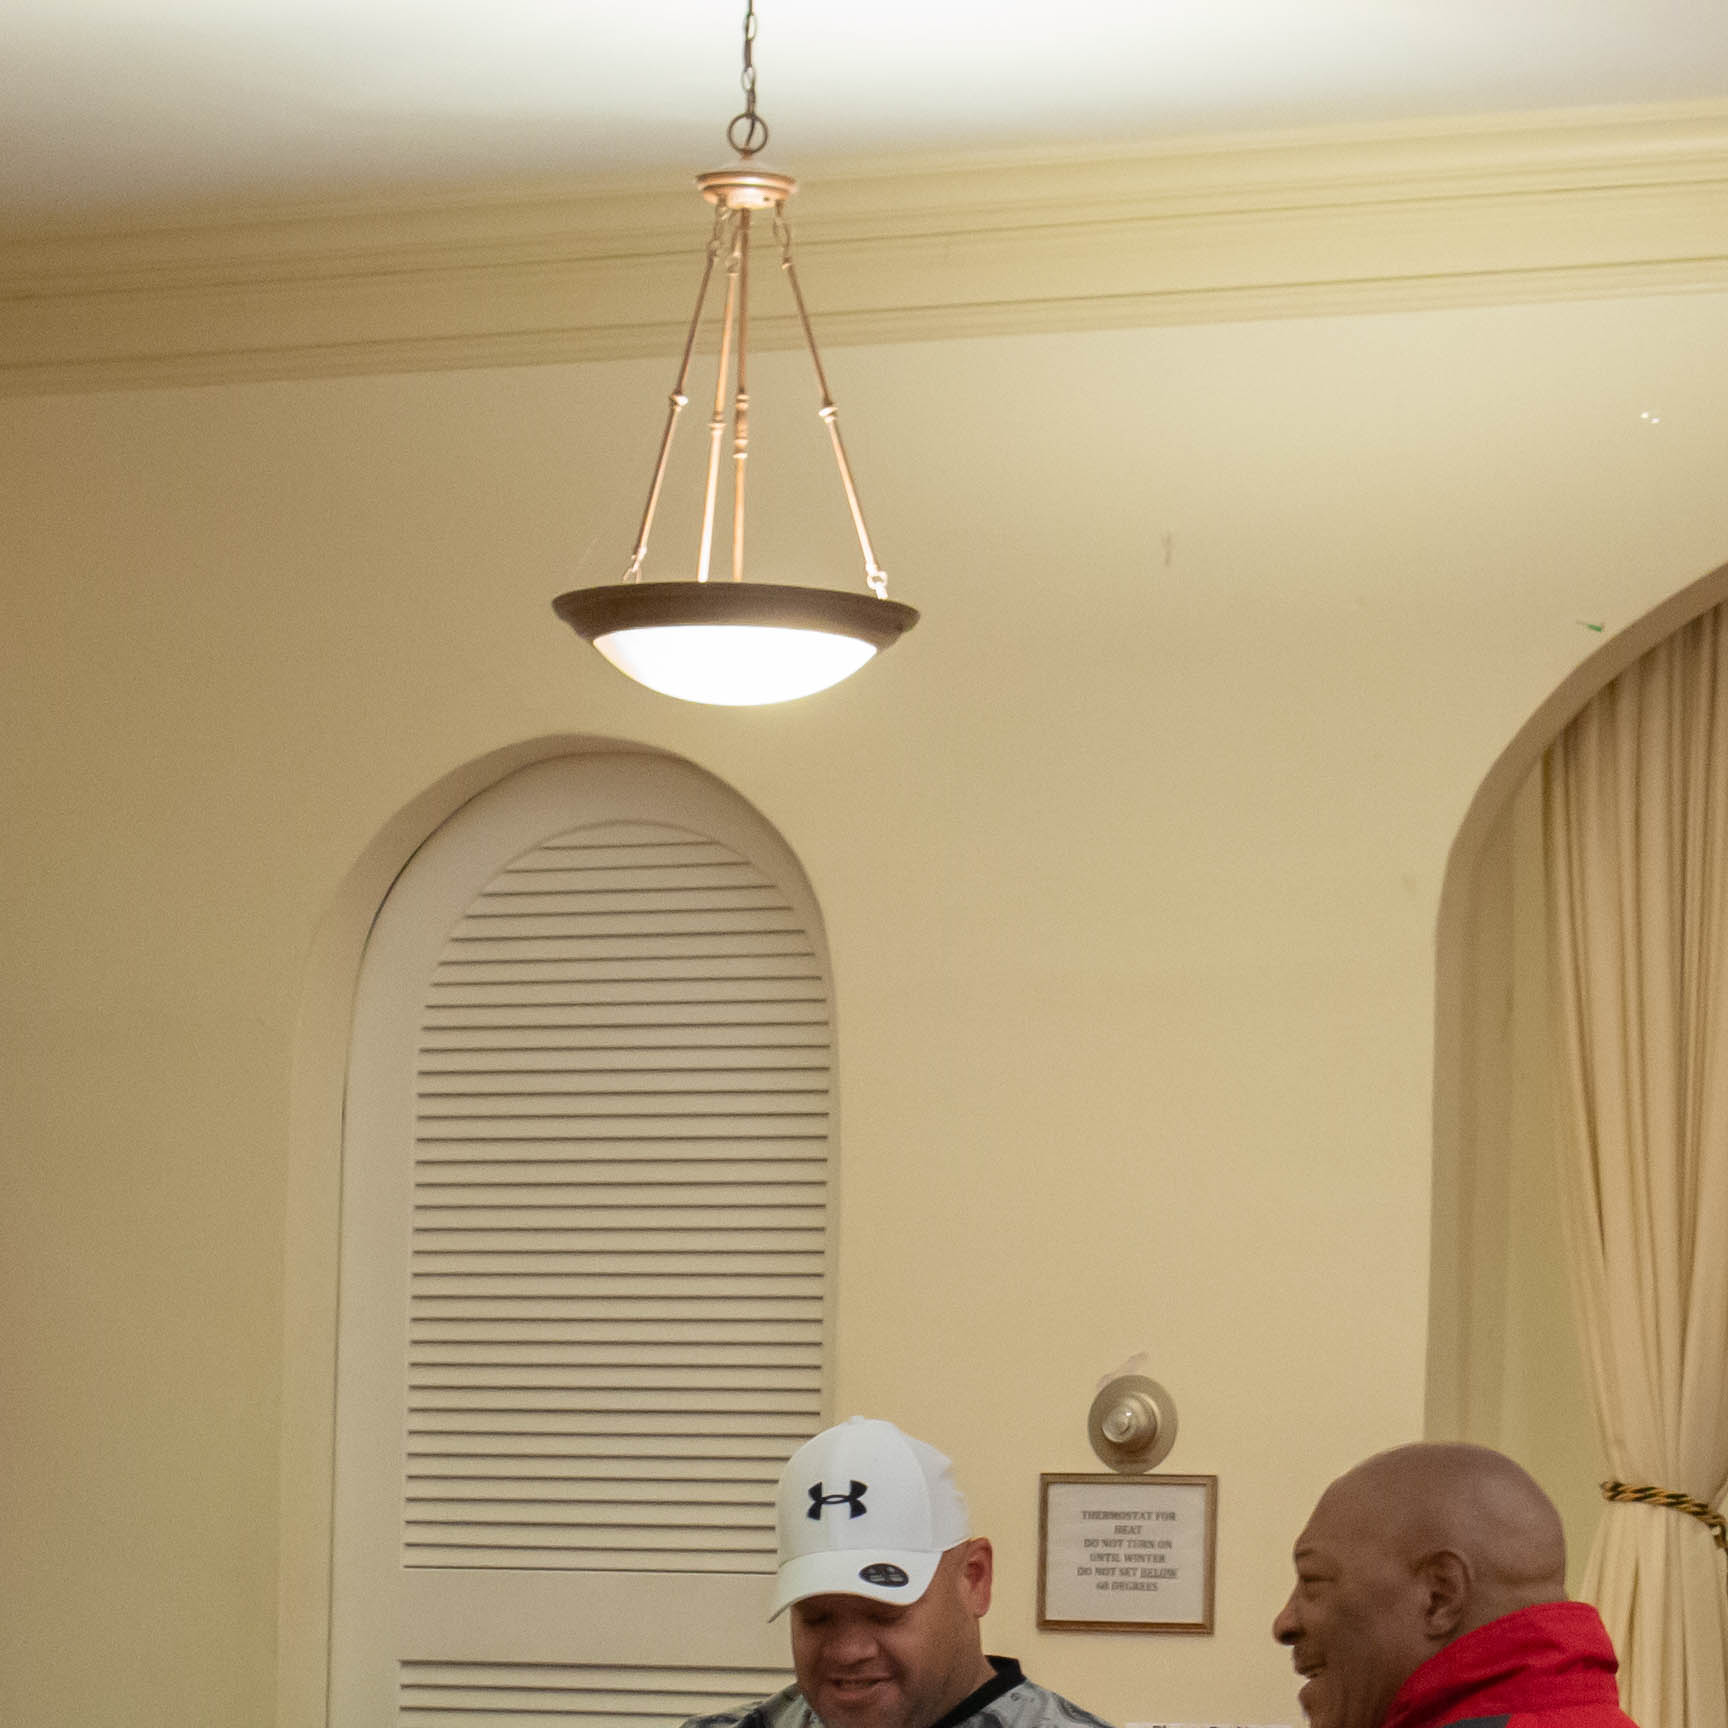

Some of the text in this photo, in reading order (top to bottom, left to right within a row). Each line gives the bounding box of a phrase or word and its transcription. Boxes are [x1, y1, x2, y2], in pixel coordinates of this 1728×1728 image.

[1081, 1511, 1176, 1520] THERMOSTAT FOR
[1114, 1525, 1142, 1534] HEAT
[1083, 1539, 1172, 1549] DO NOT TURN ON
[1090, 1553, 1166, 1563] UNTIL WINTER
[1077, 1567, 1178, 1578] DO NOT SET BELOW
[1111, 1582, 1159, 1592] DEGREES
